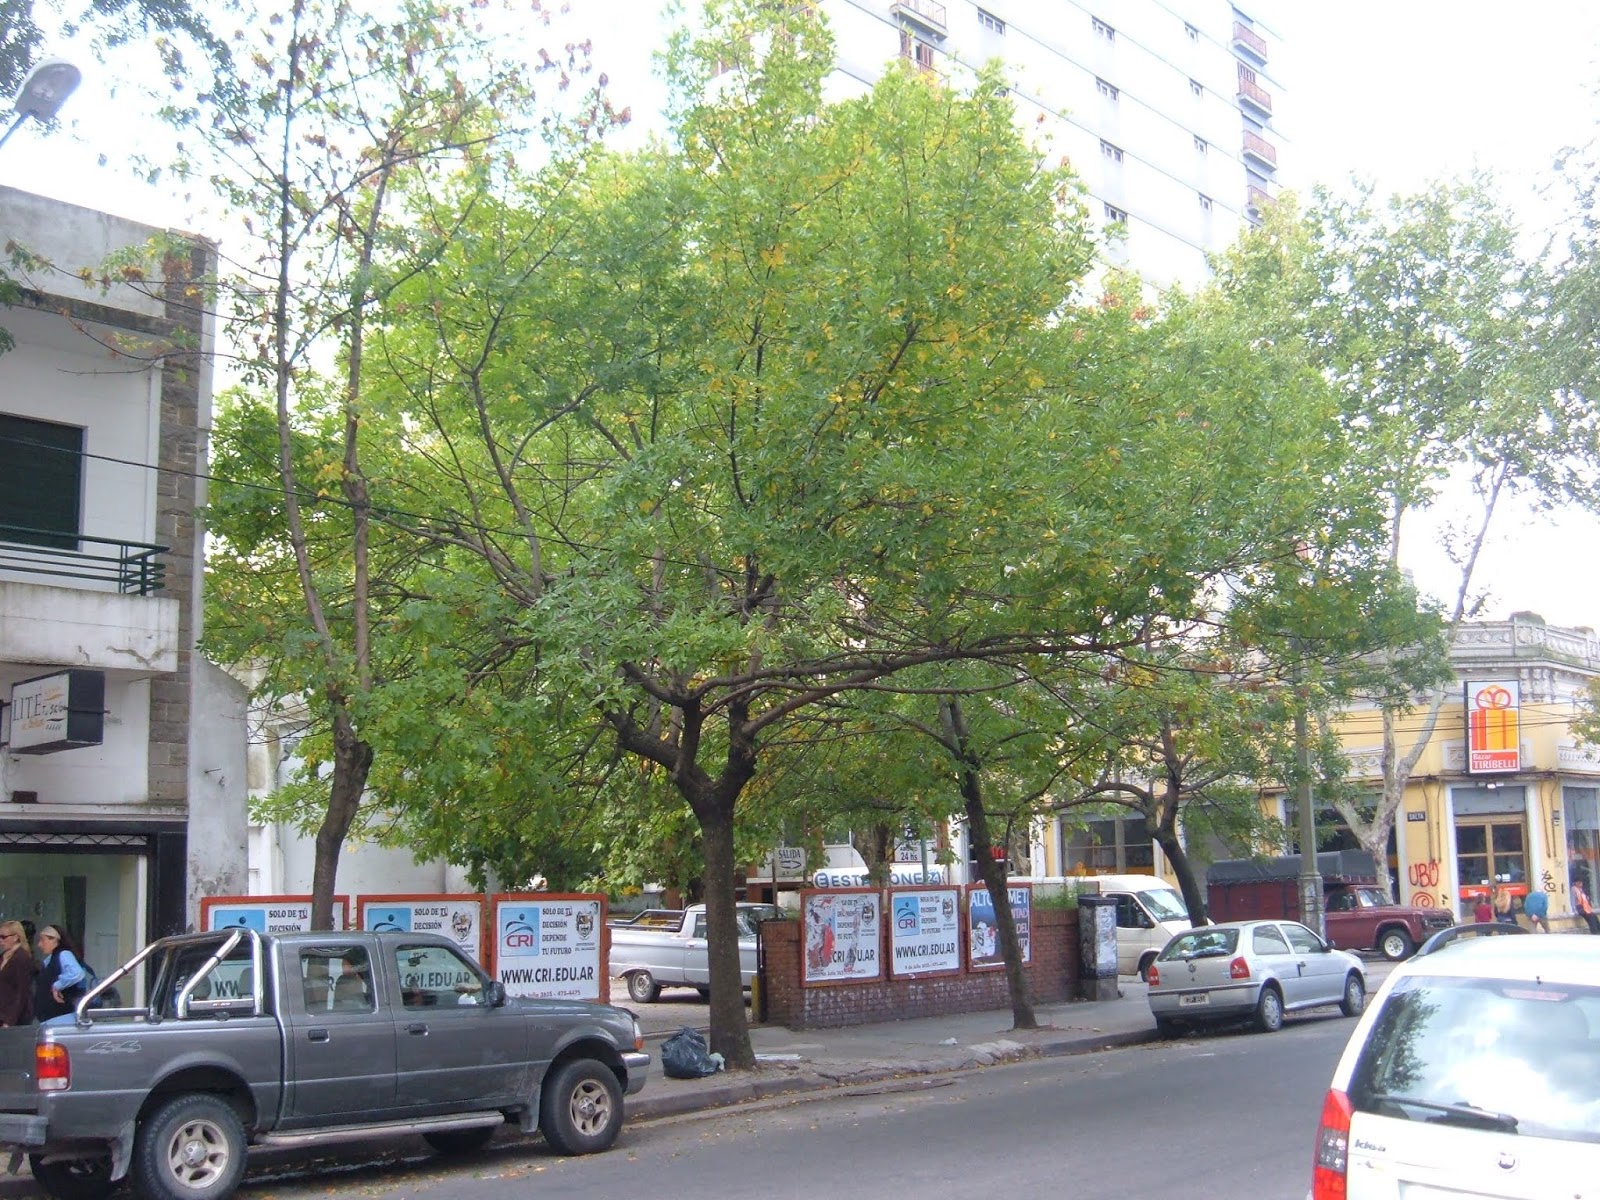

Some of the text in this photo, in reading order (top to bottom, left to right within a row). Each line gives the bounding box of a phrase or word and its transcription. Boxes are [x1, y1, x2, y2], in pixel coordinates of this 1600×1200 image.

[1473, 760, 1516, 769] TIRIBELLI
[268, 910, 286, 918] SOLO
[287, 910, 297, 918] DE
[414, 908, 430, 916] SOLO
[430, 908, 439, 916] DE
[542, 907, 556, 915] SOLO
[557, 907, 564, 915] DE
[898, 917, 916, 929] CRI
[506, 934, 533, 948] CRI
[542, 934, 567, 942] DEPENDE
[550, 947, 572, 955] FUTURO
[896, 943, 956, 959] WWW.CRI.EDU.AR
[501, 966, 594, 984] WWW.CRI.EDU.AR
